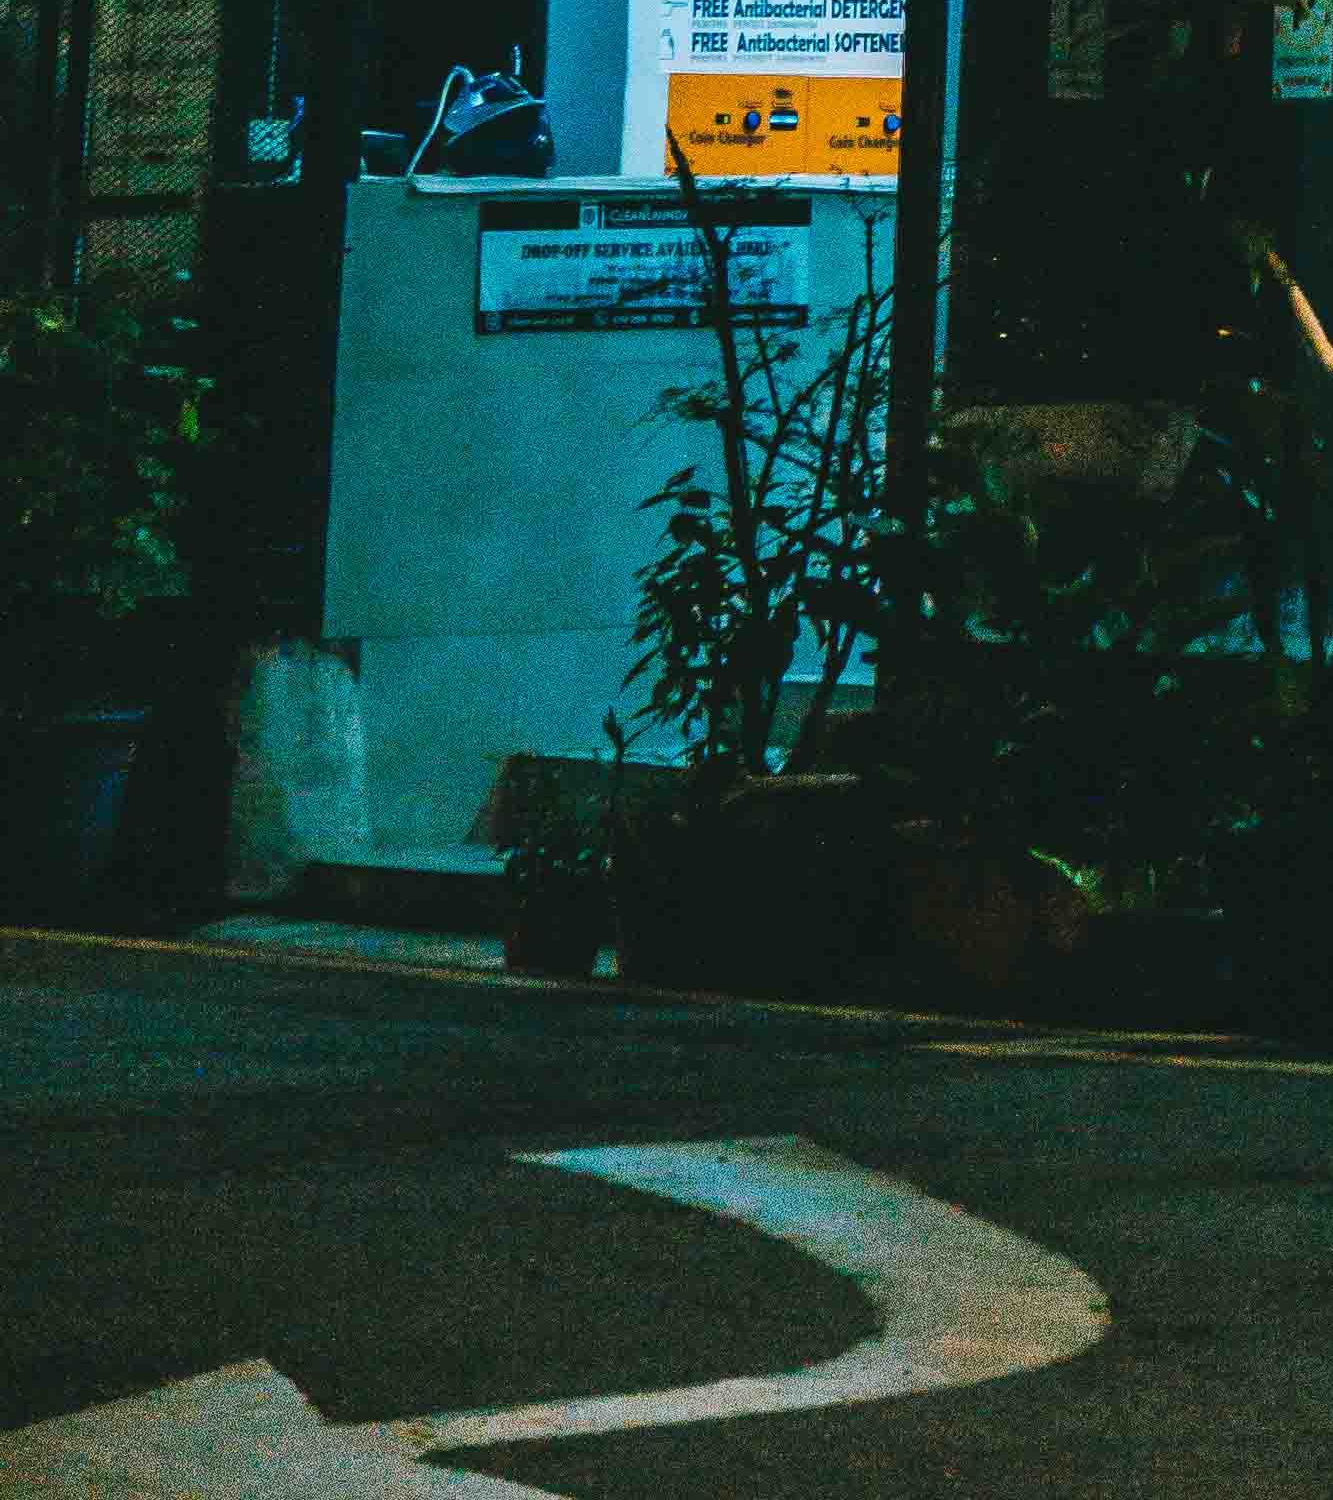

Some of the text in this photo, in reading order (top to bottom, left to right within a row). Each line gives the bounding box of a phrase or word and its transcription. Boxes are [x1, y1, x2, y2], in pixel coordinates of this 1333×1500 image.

[691, 32, 904, 54] FREE Antibacterial SOFTENE
